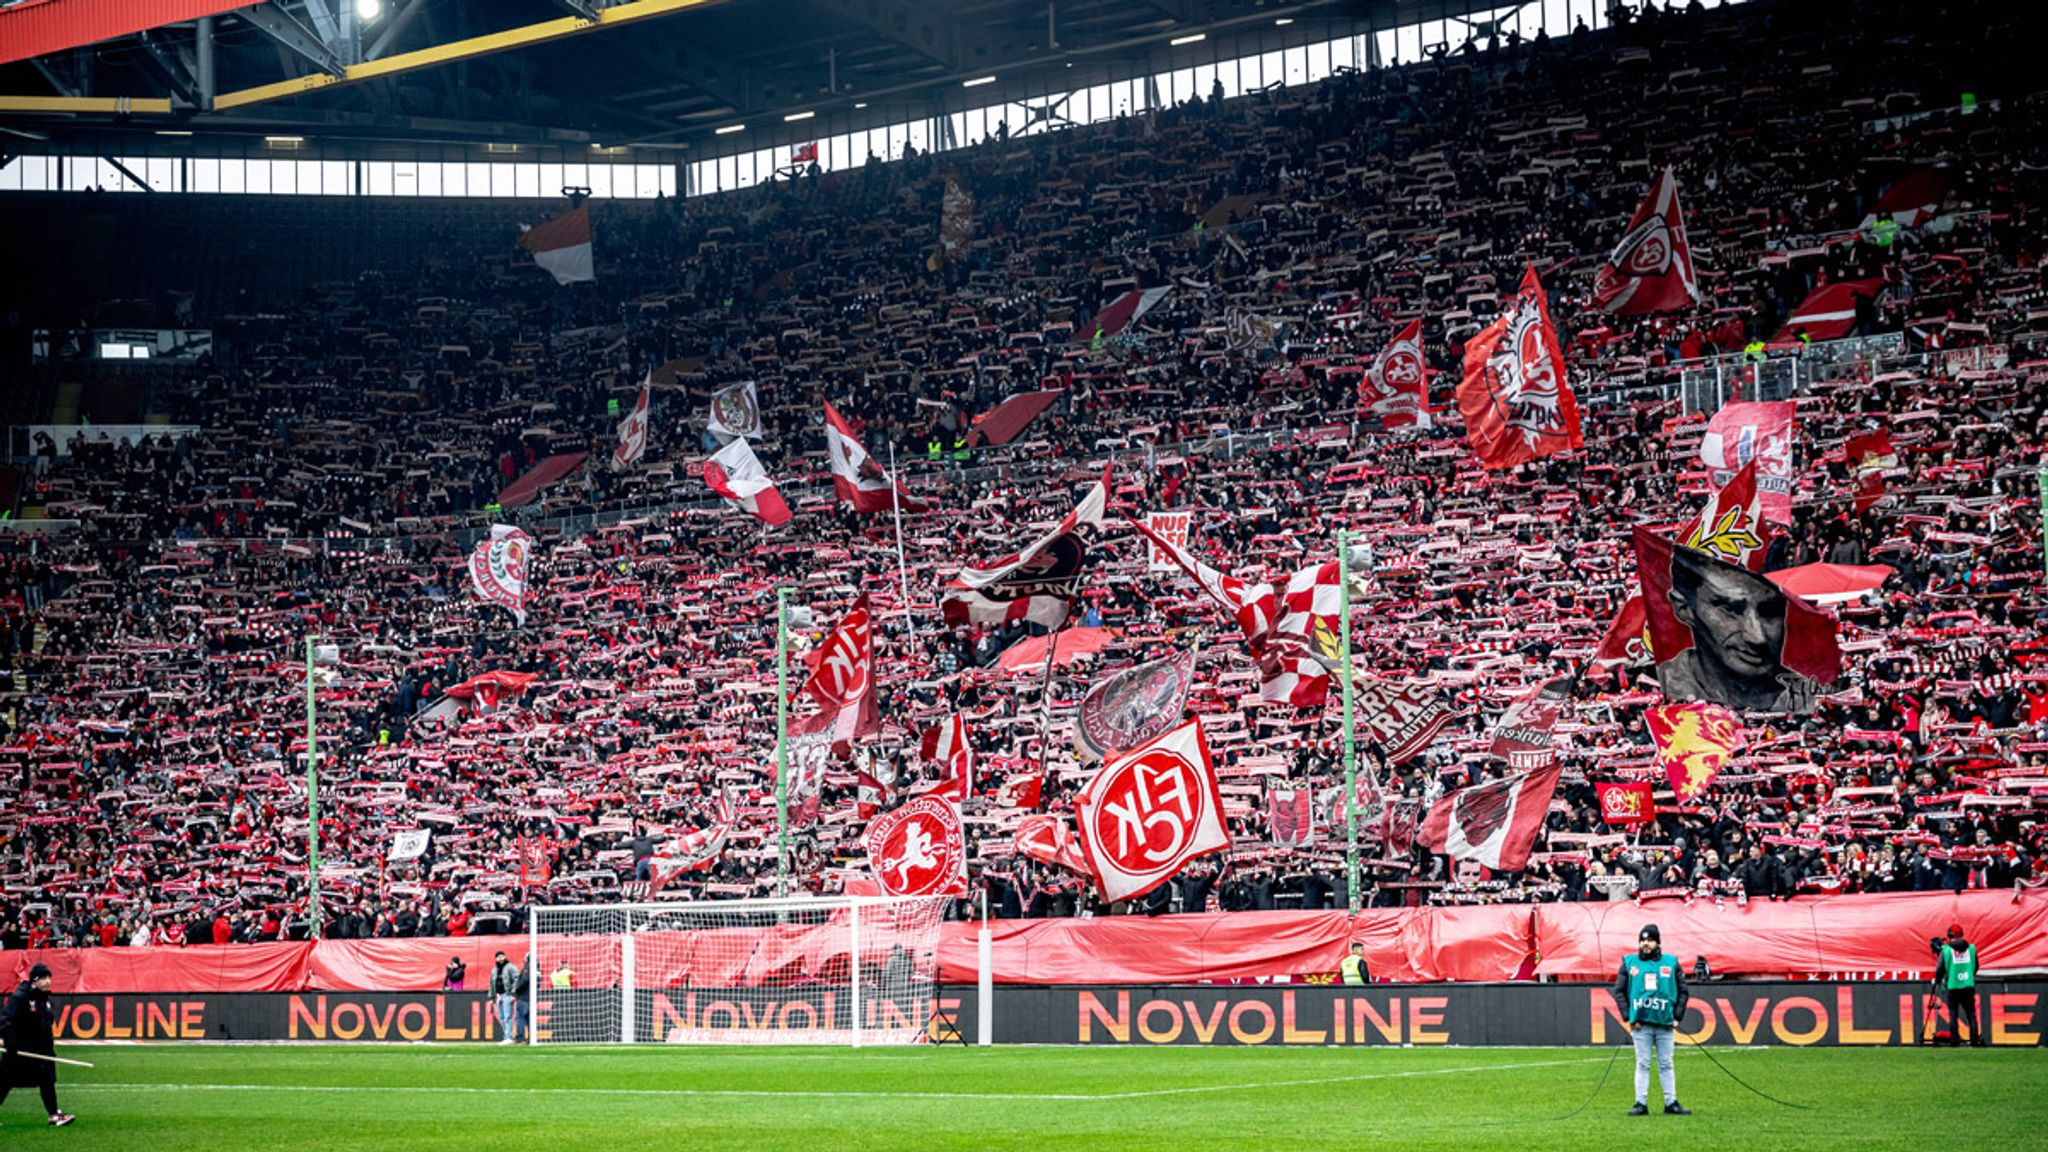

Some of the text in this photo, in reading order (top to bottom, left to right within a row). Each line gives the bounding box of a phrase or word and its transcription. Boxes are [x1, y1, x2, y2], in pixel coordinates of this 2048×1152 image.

[1152, 516, 1188, 531] NUR
[1153, 532, 1186, 549] ER
[1633, 997, 1669, 1011] HOST
[51, 996, 207, 1039] VOLINE
[1078, 990, 1450, 1044] NOVOLINE
